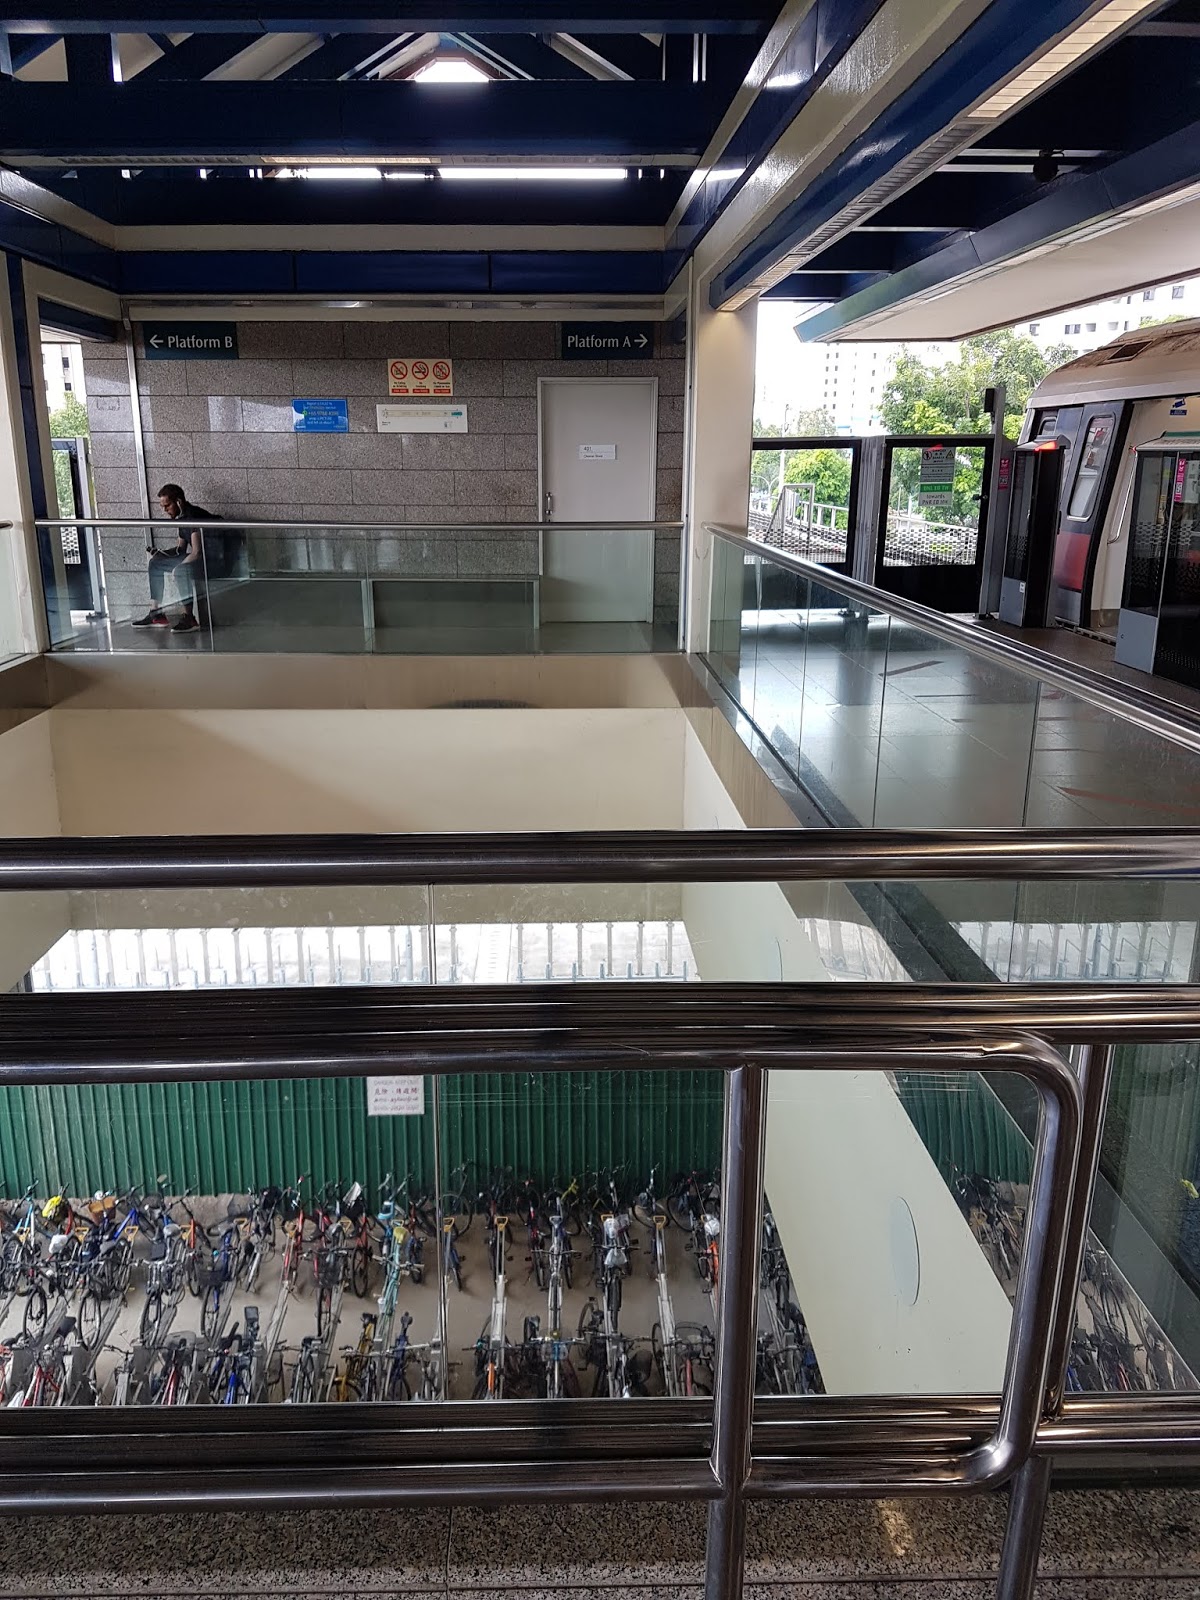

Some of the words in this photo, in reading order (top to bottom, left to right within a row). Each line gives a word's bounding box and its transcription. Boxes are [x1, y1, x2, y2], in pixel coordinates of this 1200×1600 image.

[167, 335, 220, 348] Platform
[225, 336, 233, 348] B
[567, 334, 619, 348] Platform
[622, 335, 632, 348] A
